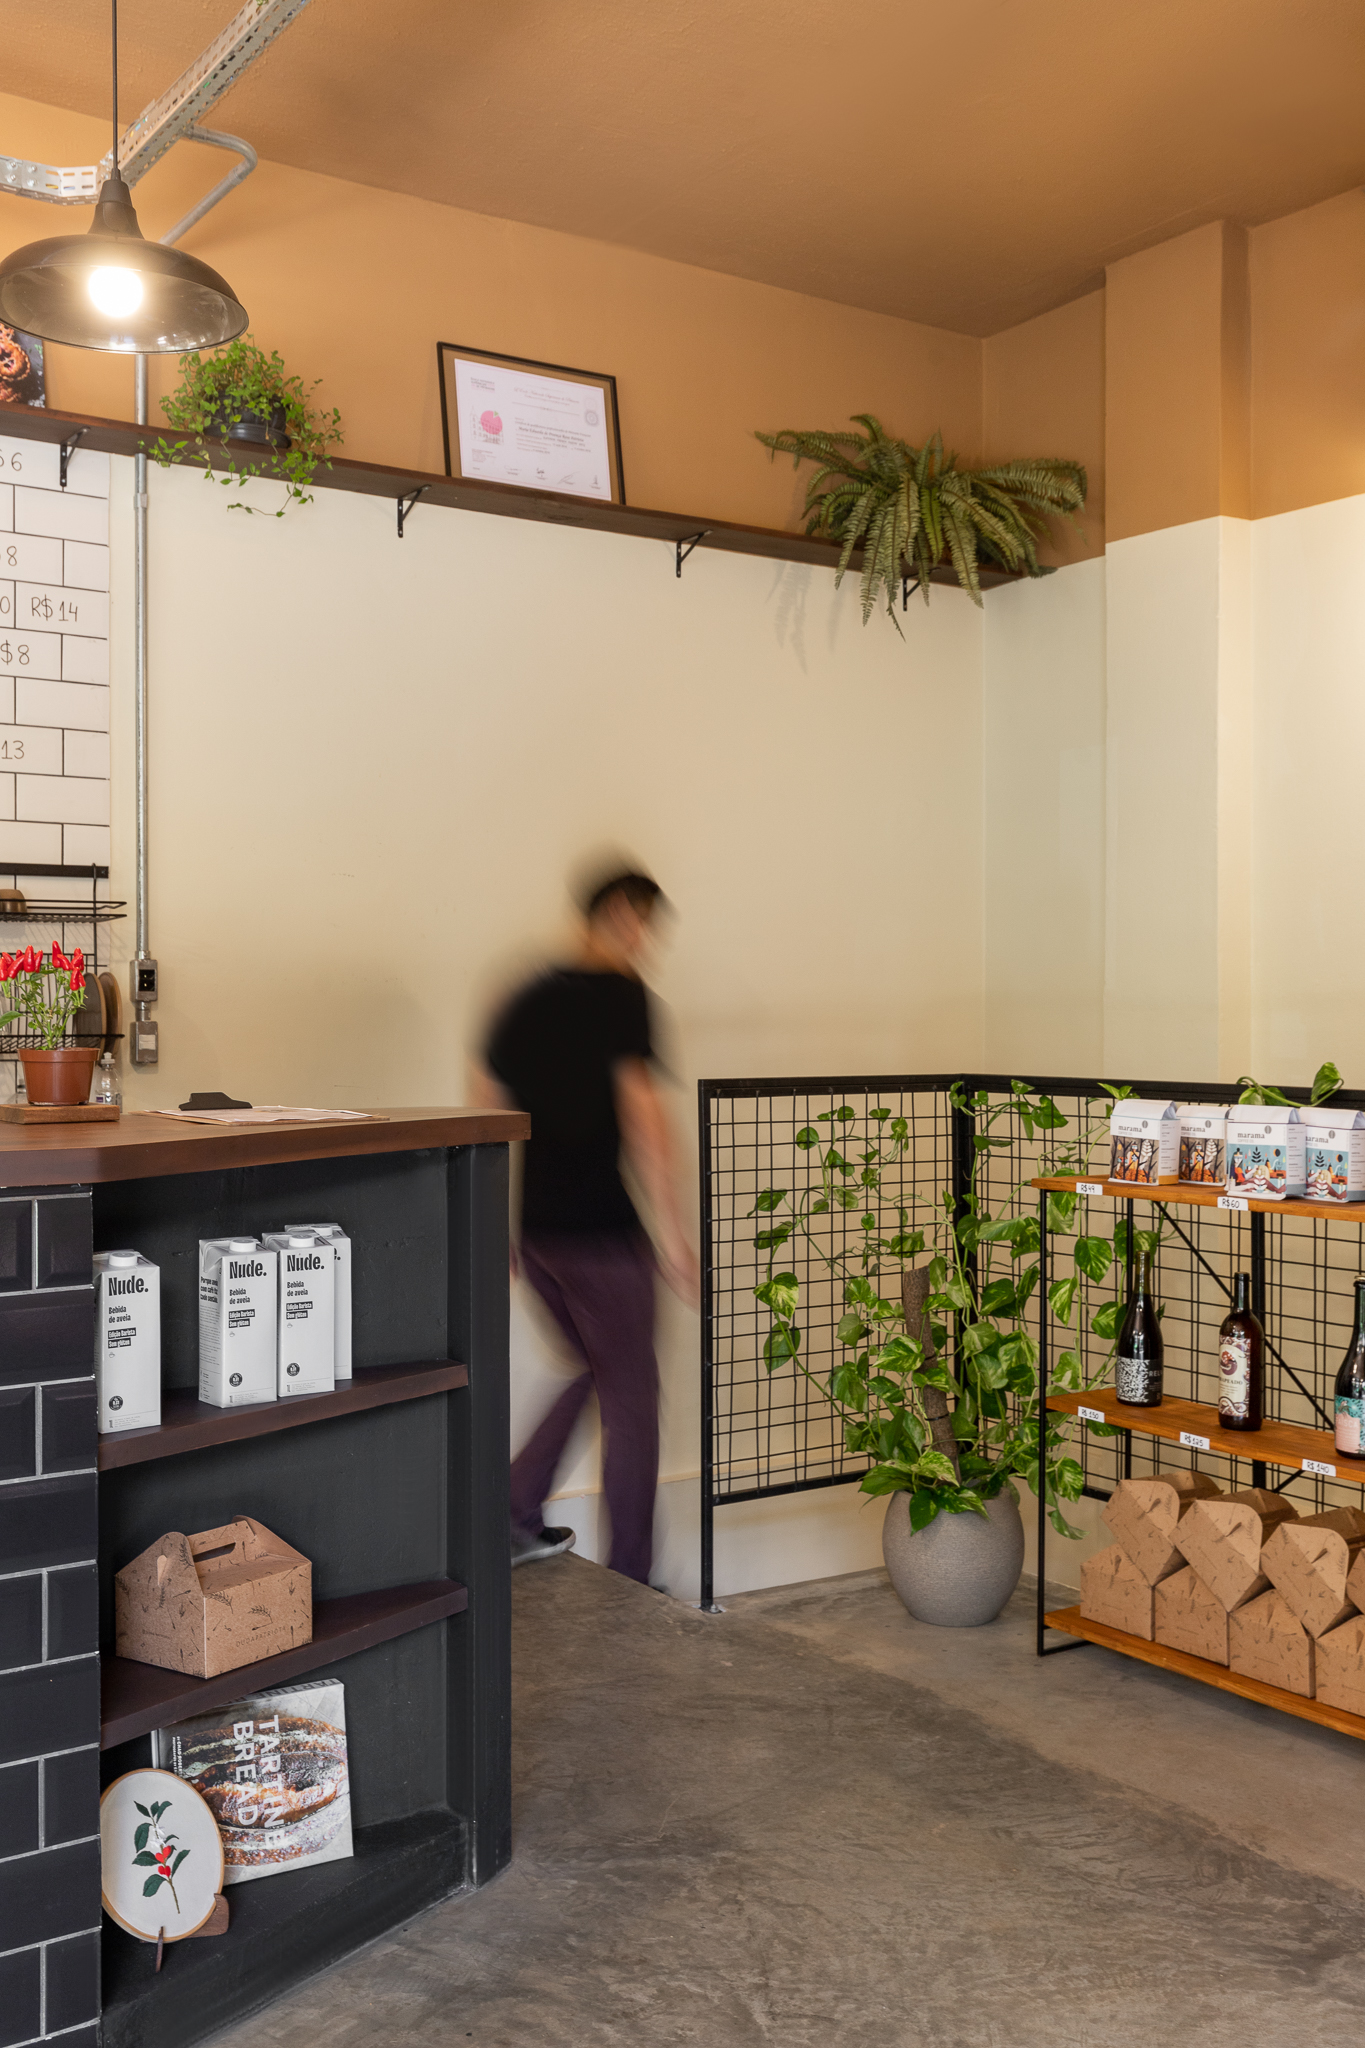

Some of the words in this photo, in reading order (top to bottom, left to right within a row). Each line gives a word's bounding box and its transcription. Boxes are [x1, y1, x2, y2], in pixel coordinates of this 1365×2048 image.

[287, 1253, 325, 1272] Nude.
[229, 1260, 267, 1279] Nude.
[108, 1275, 149, 1297] Nude.
[287, 1280, 304, 1288] Bebida
[229, 1288, 247, 1296] Bebida
[287, 1289, 294, 1297] de
[294, 1288, 308, 1296] aveia
[229, 1297, 236, 1305] de
[236, 1295, 251, 1304] aveia
[108, 1305, 127, 1315] Bebida
[108, 1315, 116, 1324] de
[116, 1313, 131, 1323] aveia
[233, 1720, 259, 1826] BREAD
[259, 1714, 286, 1848] TARTINE
